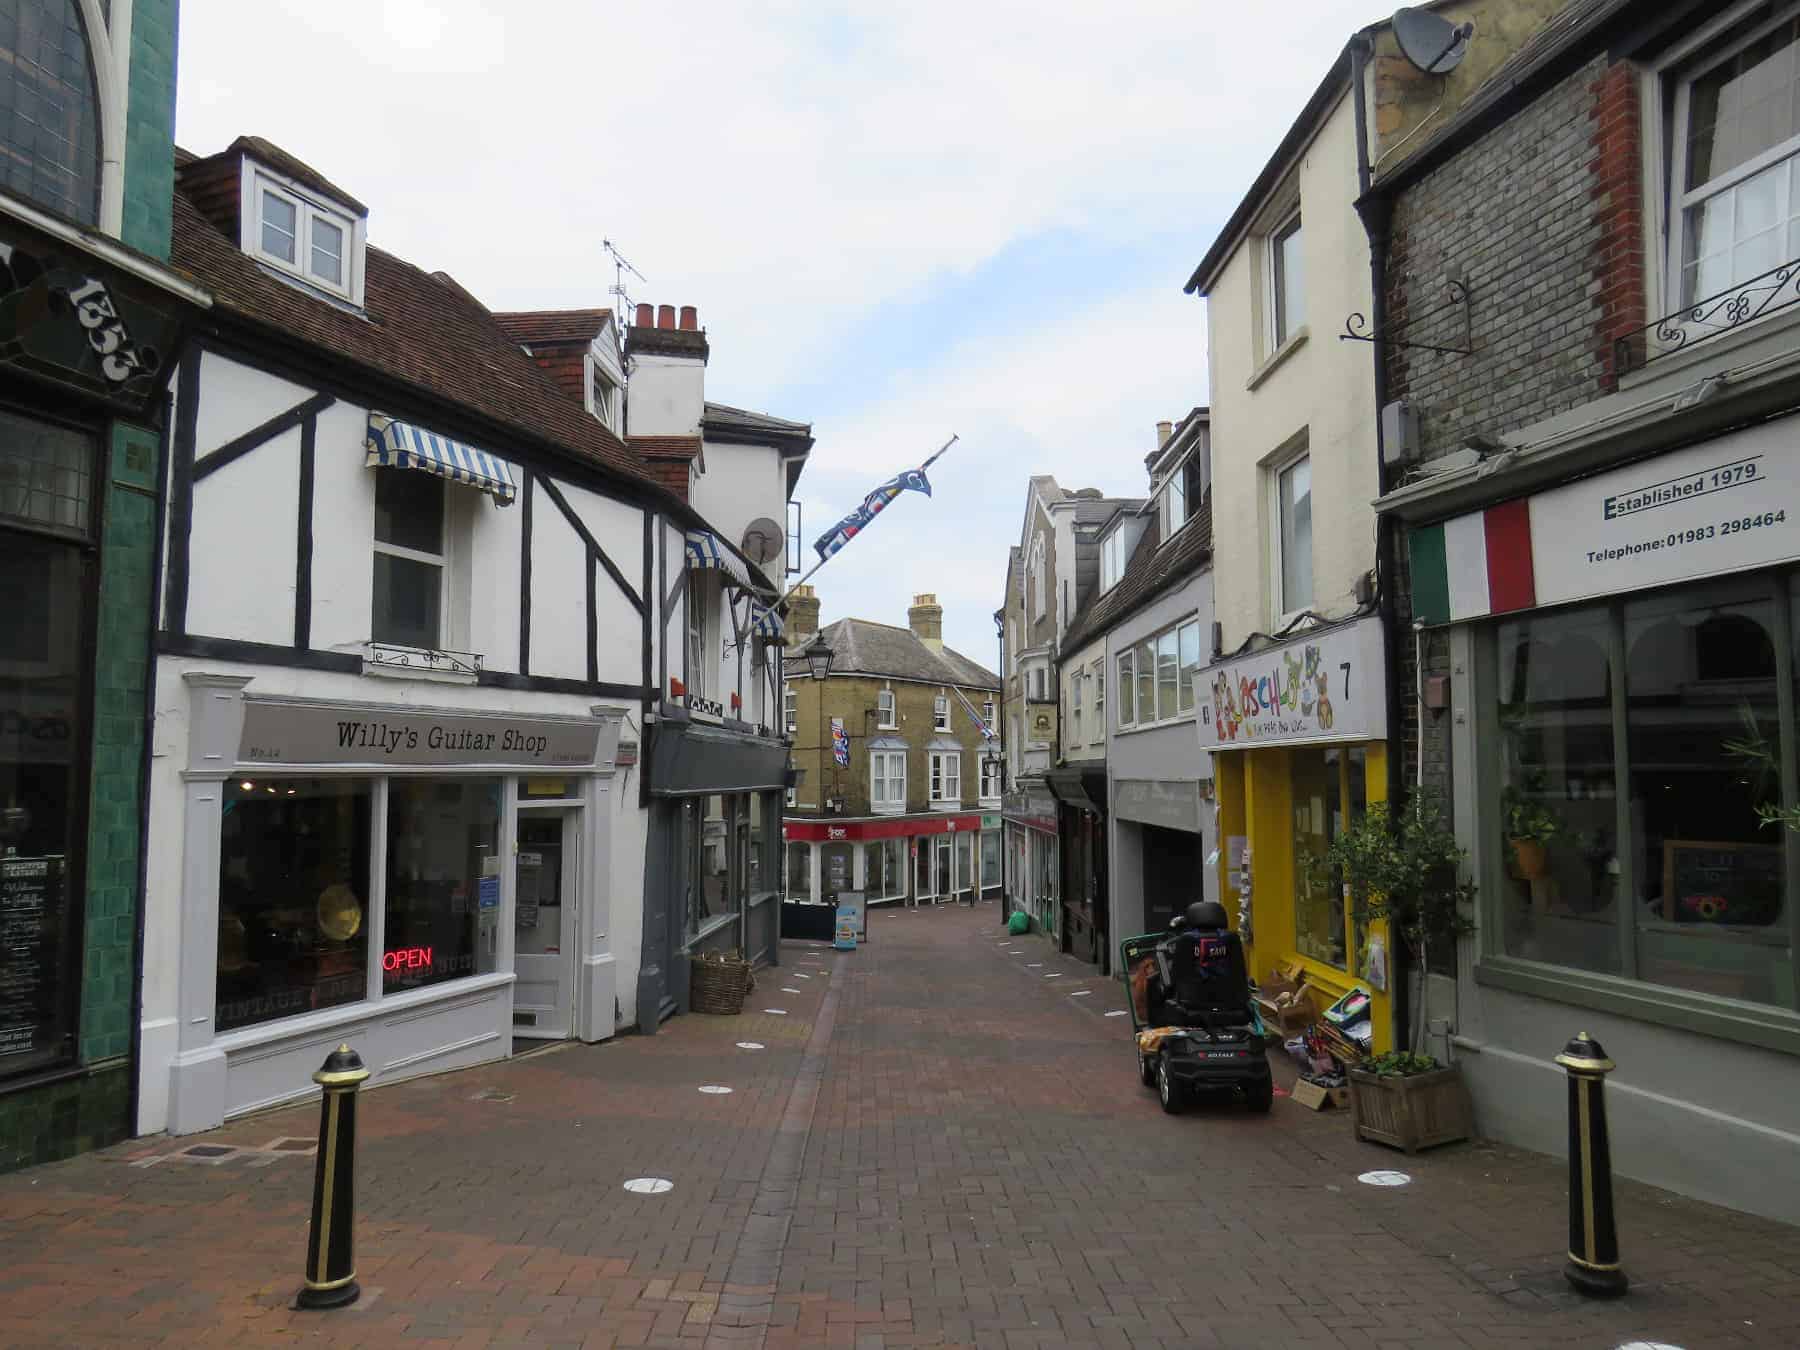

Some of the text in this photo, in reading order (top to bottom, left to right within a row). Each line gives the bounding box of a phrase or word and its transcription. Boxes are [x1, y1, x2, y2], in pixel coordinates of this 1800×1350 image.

[1603, 463, 1757, 520] Established 1979
[1720, 509, 1786, 536] 298464
[1339, 662, 1351, 701] 7
[336, 720, 549, 758] Willy's Guitar Shop
[382, 948, 432, 970] OPEN
